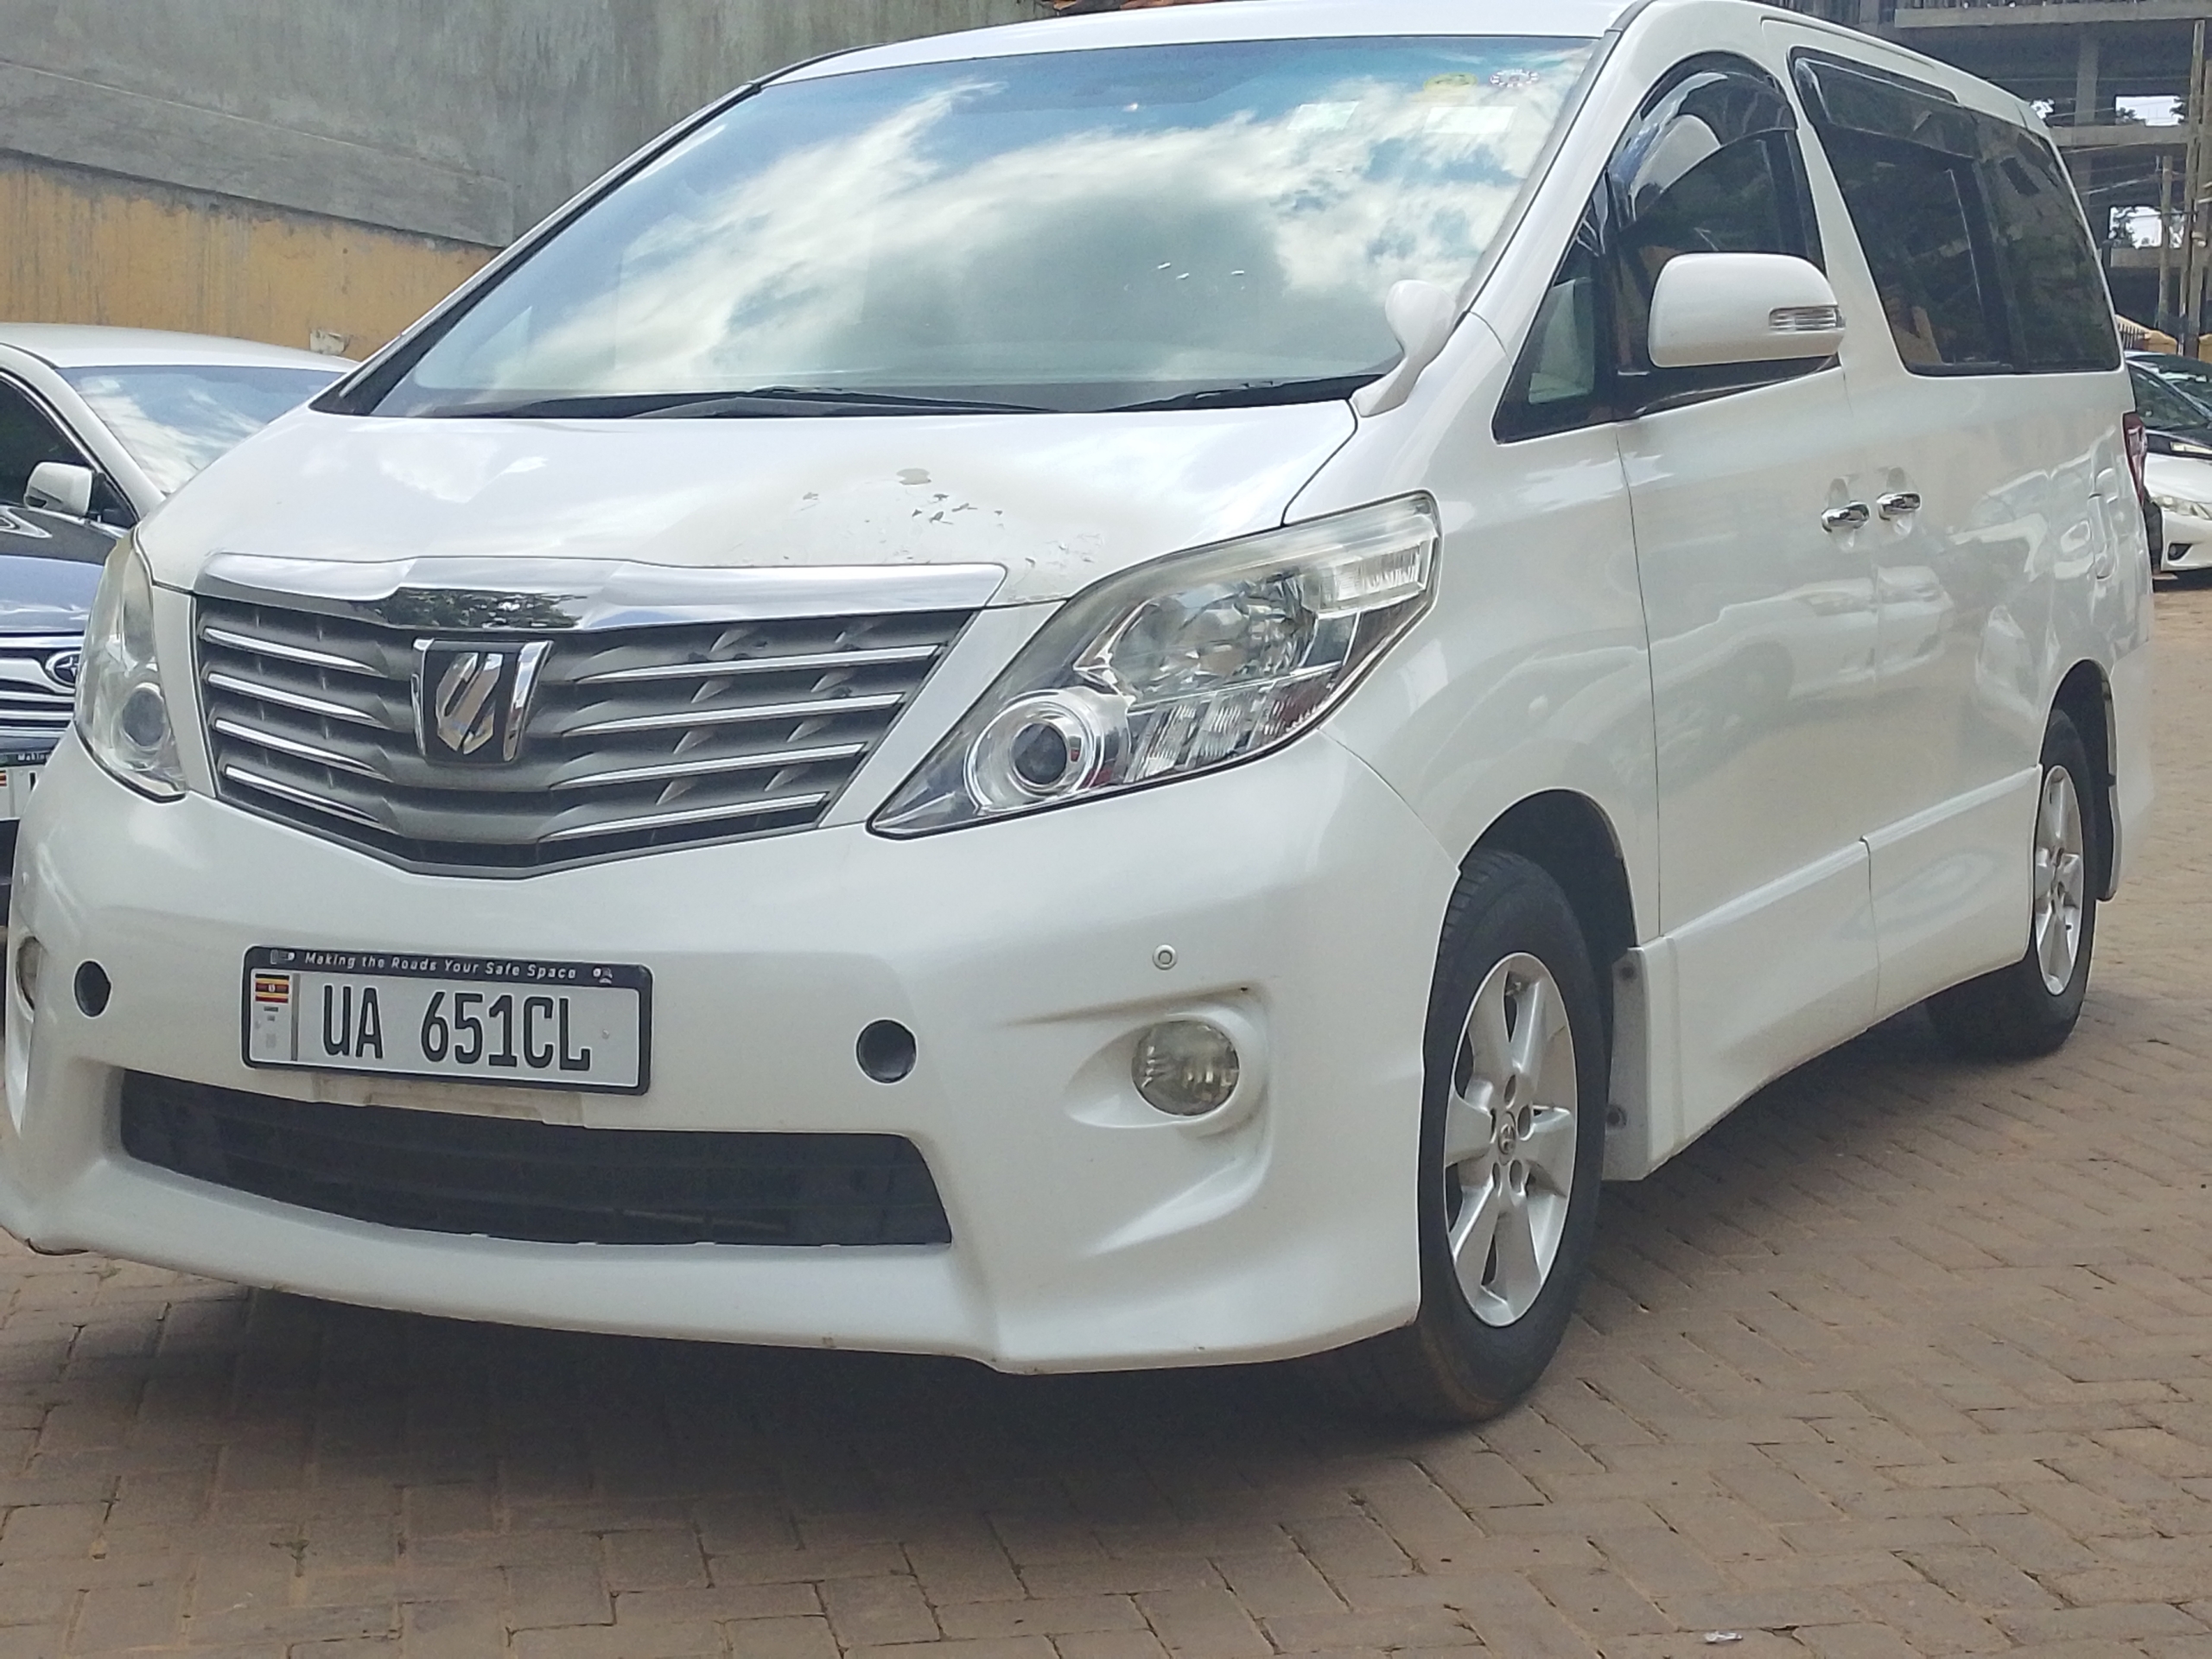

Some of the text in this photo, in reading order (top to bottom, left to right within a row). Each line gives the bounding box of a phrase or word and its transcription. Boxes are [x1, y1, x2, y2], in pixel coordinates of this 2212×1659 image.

[304, 951, 577, 980] Making the Roads Your Safe Space
[322, 984, 592, 1071] UA 651CL
